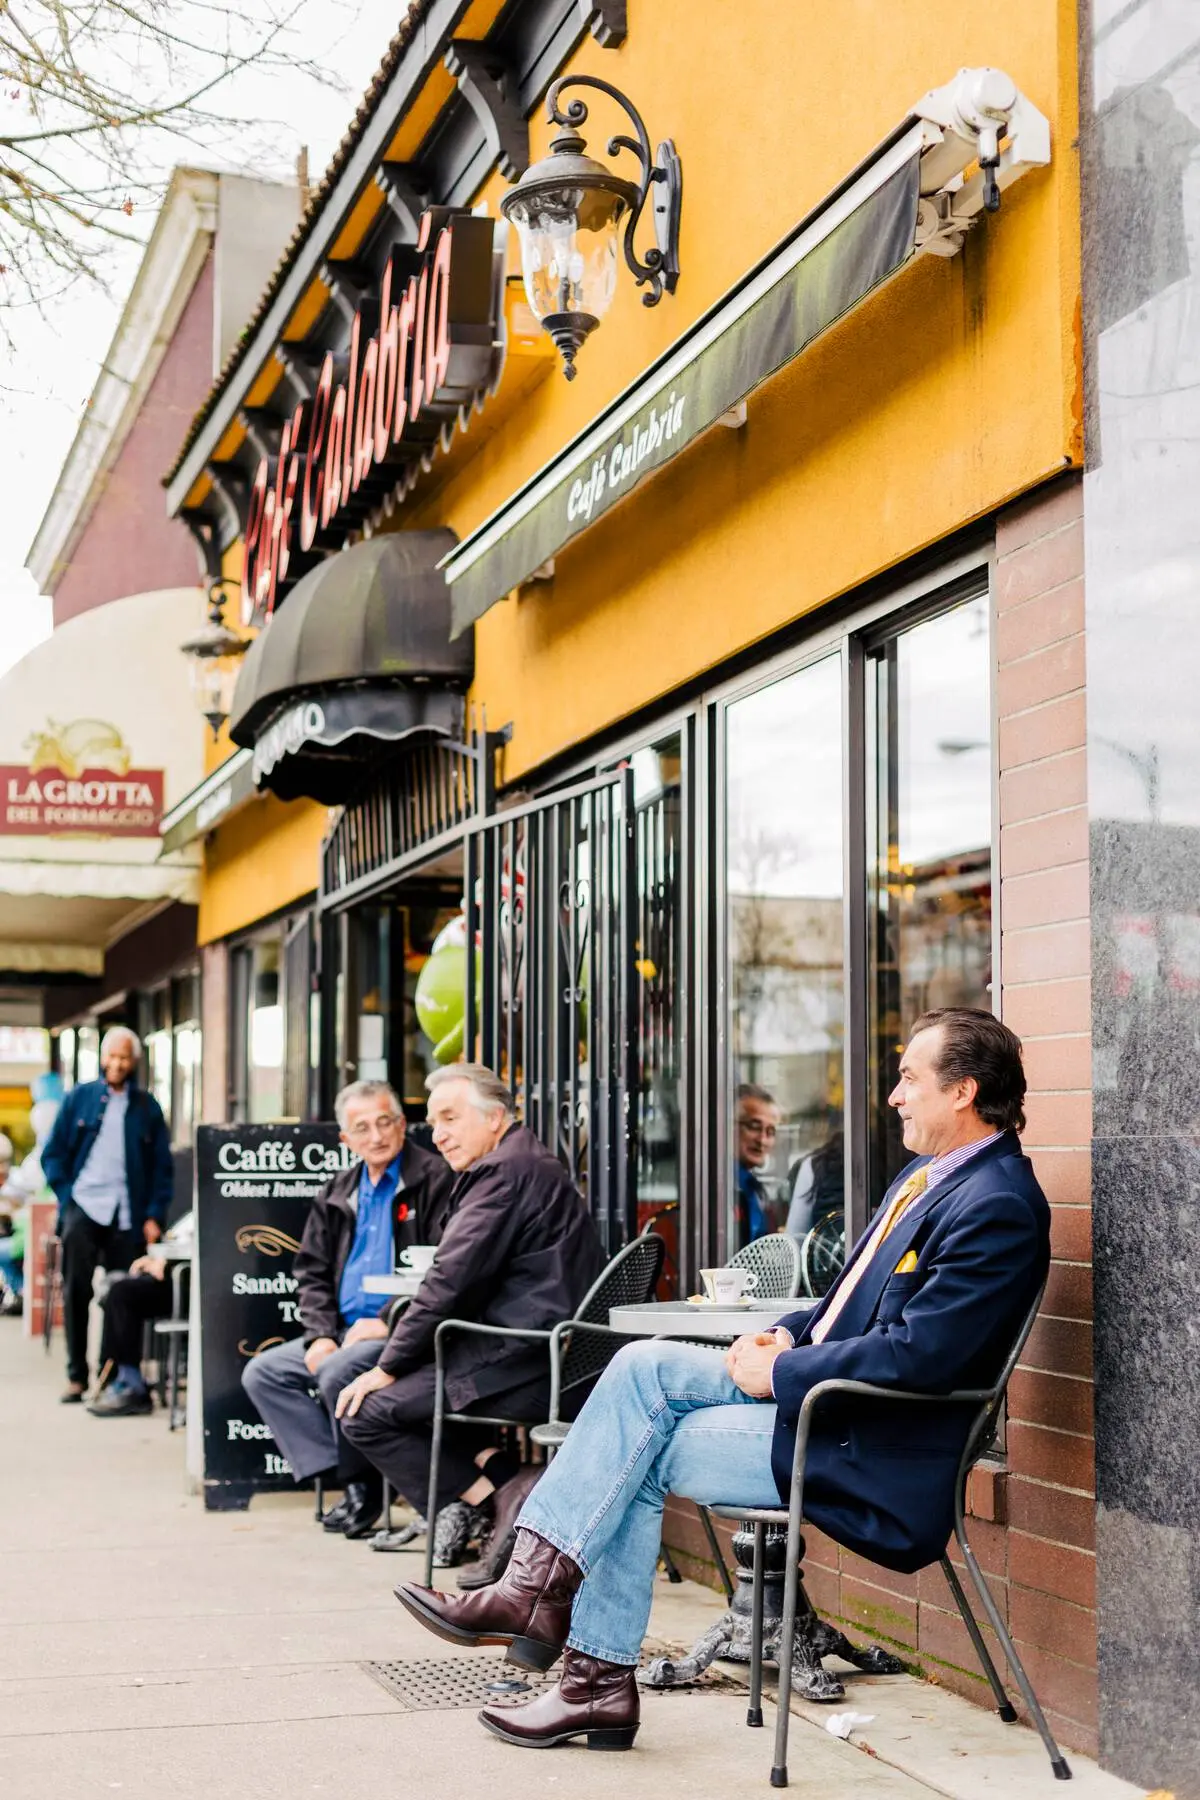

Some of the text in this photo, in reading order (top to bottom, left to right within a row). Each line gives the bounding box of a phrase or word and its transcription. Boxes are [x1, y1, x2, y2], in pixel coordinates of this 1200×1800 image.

[301, 209, 452, 553] Calabria
[567, 391, 685, 522] Café Calabria
[218, 1141, 296, 1171] Caffé
